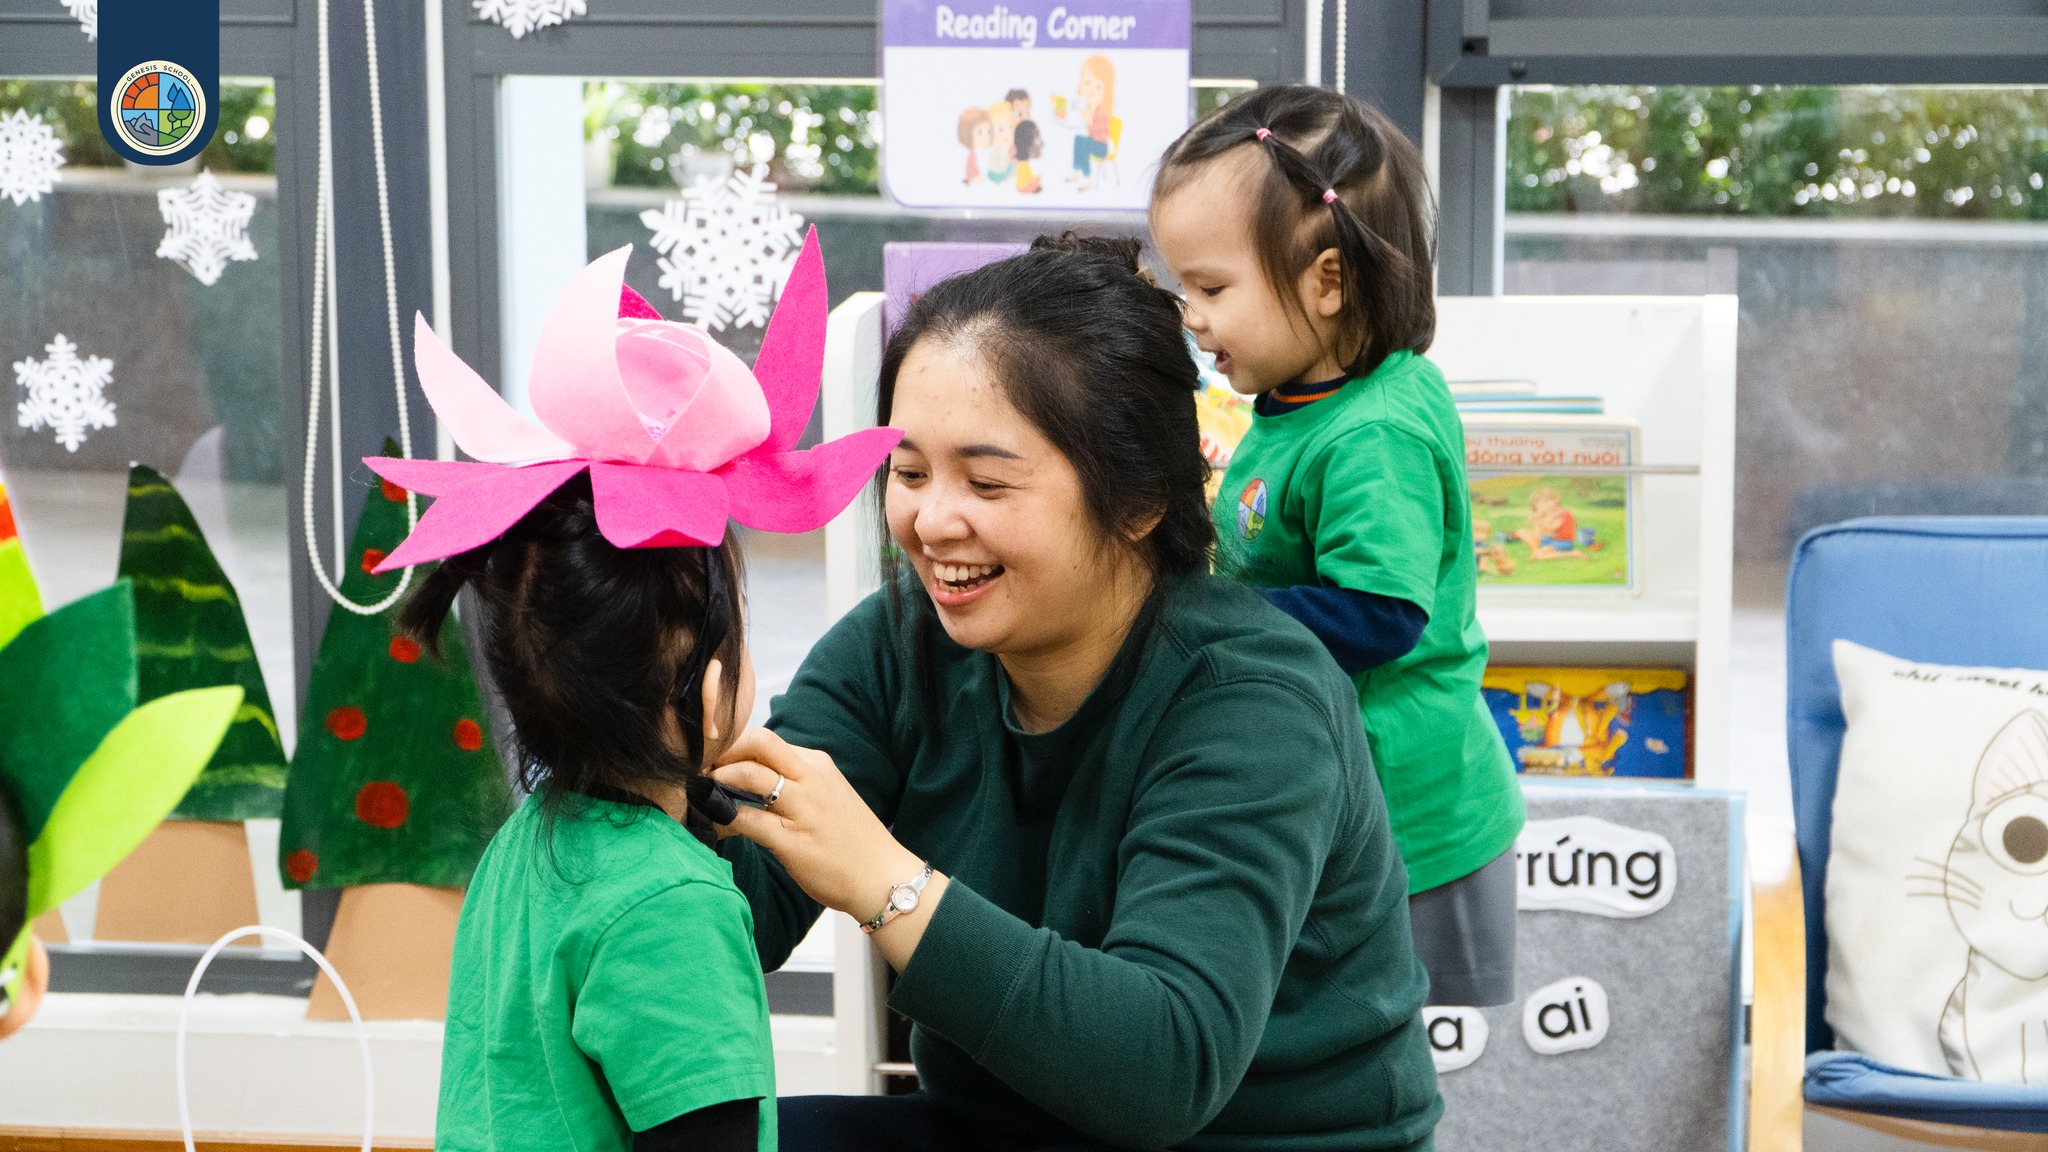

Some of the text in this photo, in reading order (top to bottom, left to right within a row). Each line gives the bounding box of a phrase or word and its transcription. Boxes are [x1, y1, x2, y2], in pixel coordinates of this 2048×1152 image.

[935, 5, 1137, 48] Reading Corner
[1516, 835, 1662, 900] rứng
[1537, 986, 1592, 1039] ai
